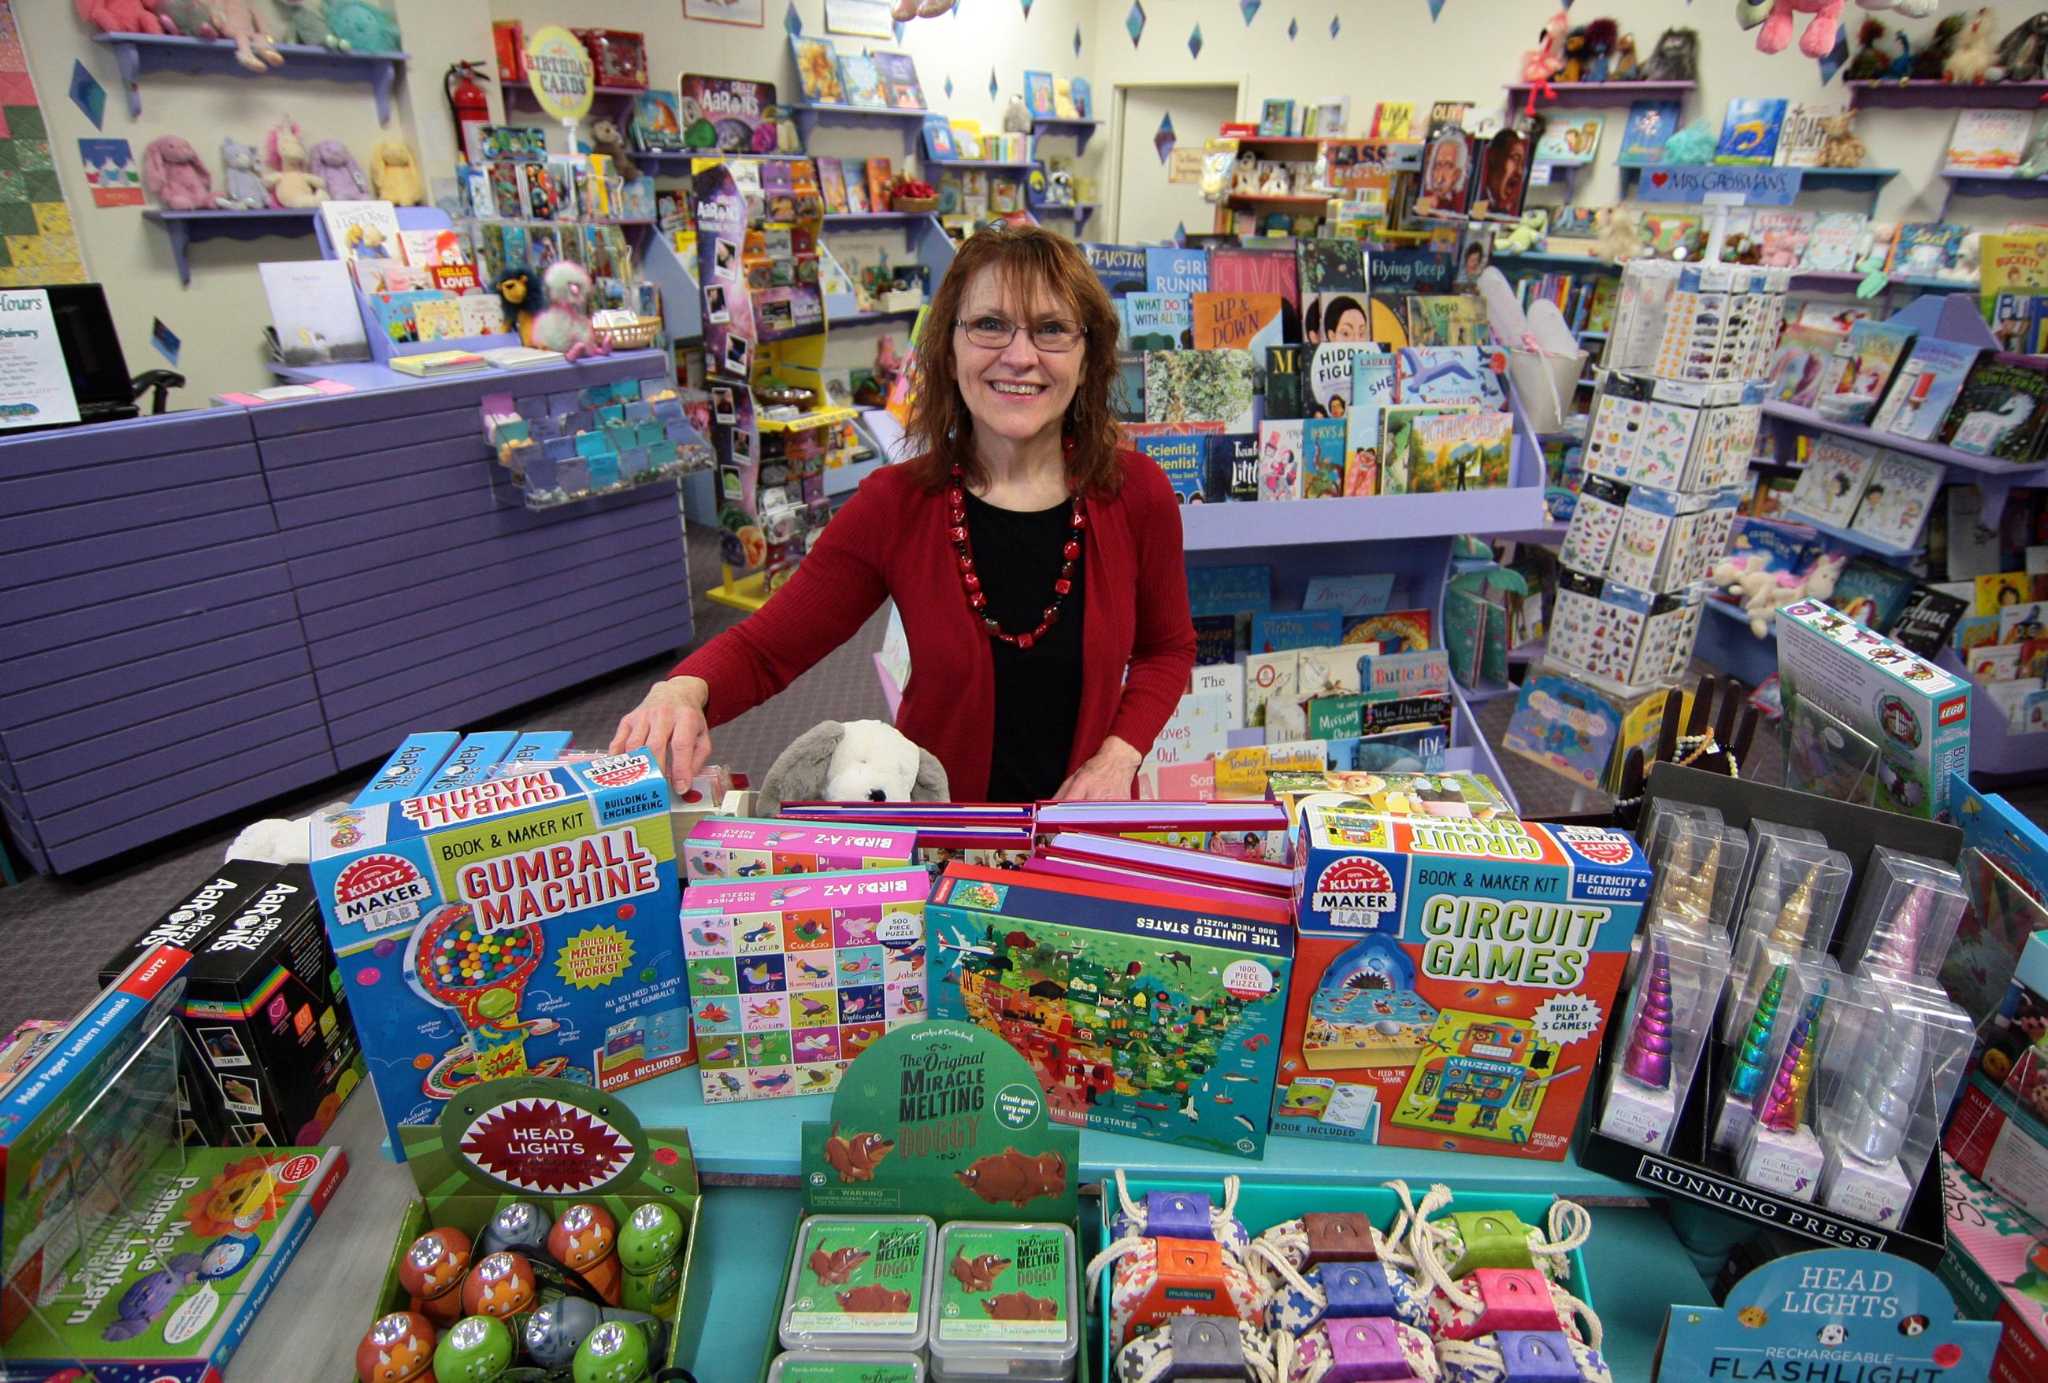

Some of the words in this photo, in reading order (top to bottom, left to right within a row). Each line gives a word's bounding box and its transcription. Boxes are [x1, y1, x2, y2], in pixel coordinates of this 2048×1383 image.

[527, 54, 594, 77] BIRTHDAY
[541, 71, 588, 95] CARDS
[1371, 259, 1412, 283] Flying
[1415, 259, 1446, 282] Deep
[440, 277, 474, 290] LOVE!
[1134, 299, 1161, 311] WHAT
[1211, 310, 1261, 350] DOWN
[1319, 366, 1352, 382] FIGU
[1201, 676, 1226, 689] The
[1941, 704, 1964, 719] LEGO
[405, 772, 546, 814] MACHINE
[604, 793, 648, 809] BUILDING
[652, 790, 661, 800] &
[412, 784, 562, 828] GUMBALL
[603, 801, 663, 821] ENGINEERING
[442, 839, 483, 862] BOOK
[490, 833, 503, 849] &
[507, 820, 557, 846] MAKER
[562, 812, 586, 832] KIT
[1415, 830, 1537, 860] CIRCUIT
[463, 829, 648, 900] GUMBALL
[347, 869, 405, 897] KLUTZ
[1329, 877, 1380, 890] KLUTZ
[1418, 869, 1457, 887] BOOK
[1463, 873, 1474, 887] &
[1480, 875, 1529, 892] MAKER
[1534, 876, 1560, 893] KIT
[1576, 873, 1637, 888] ELECTRICITY
[1638, 878, 1648, 888] &
[478, 858, 656, 931] MACHINE
[1586, 885, 1632, 897] CIRCUITS
[346, 884, 421, 918] MAKER
[1321, 895, 1388, 908] MAKER
[371, 906, 412, 928] LAB
[1136, 917, 1190, 934] STATES
[1337, 911, 1372, 924] LAB
[1424, 898, 1608, 948] CIRCUIT
[1193, 926, 1247, 943] UNITED
[1251, 934, 1281, 948] THE
[570, 943, 624, 959] MACHINE
[568, 958, 591, 969] THAT
[594, 954, 625, 967] REALLY
[575, 963, 618, 979] WORKS!
[1238, 965, 1257, 974] 1000
[1424, 941, 1583, 987] GAMES
[1230, 980, 1263, 989] PUZZLE
[1234, 973, 1260, 981] PIECE
[1549, 1004, 1579, 1013] BUILD
[1581, 1004, 1589, 1012] &
[1555, 1012, 1581, 1021] PLAY
[1541, 1021, 1549, 1030] 5
[1552, 1021, 1592, 1031] GAMES!
[602, 1072, 631, 1088] BOOK
[634, 1056, 683, 1079] INCLUDED
[900, 1053, 922, 1069] The
[922, 1051, 986, 1074] Original
[901, 1067, 986, 1098] MIRACLE
[899, 1086, 985, 1123] MELTING
[1050, 1107, 1066, 1118] THE
[1068, 1111, 1102, 1124] UNITED
[1103, 1117, 1138, 1130] STATES
[513, 1127, 575, 1141] HEAD
[1273, 1123, 1301, 1133] BOOK
[1306, 1126, 1357, 1138] INCLUDED
[507, 1141, 586, 1156] LIGHTS
[1648, 1164, 1779, 1219] RUNNING
[1787, 1211, 1873, 1250] PRESS
[1016, 1253, 1060, 1270] MELTING
[1798, 1266, 1894, 1293] HEAD
[1781, 1290, 1899, 1320] LIGHTS
[1764, 1346, 1895, 1366] RECHARGEABLE
[1708, 1356, 1945, 1383] FLASHLIGHT
